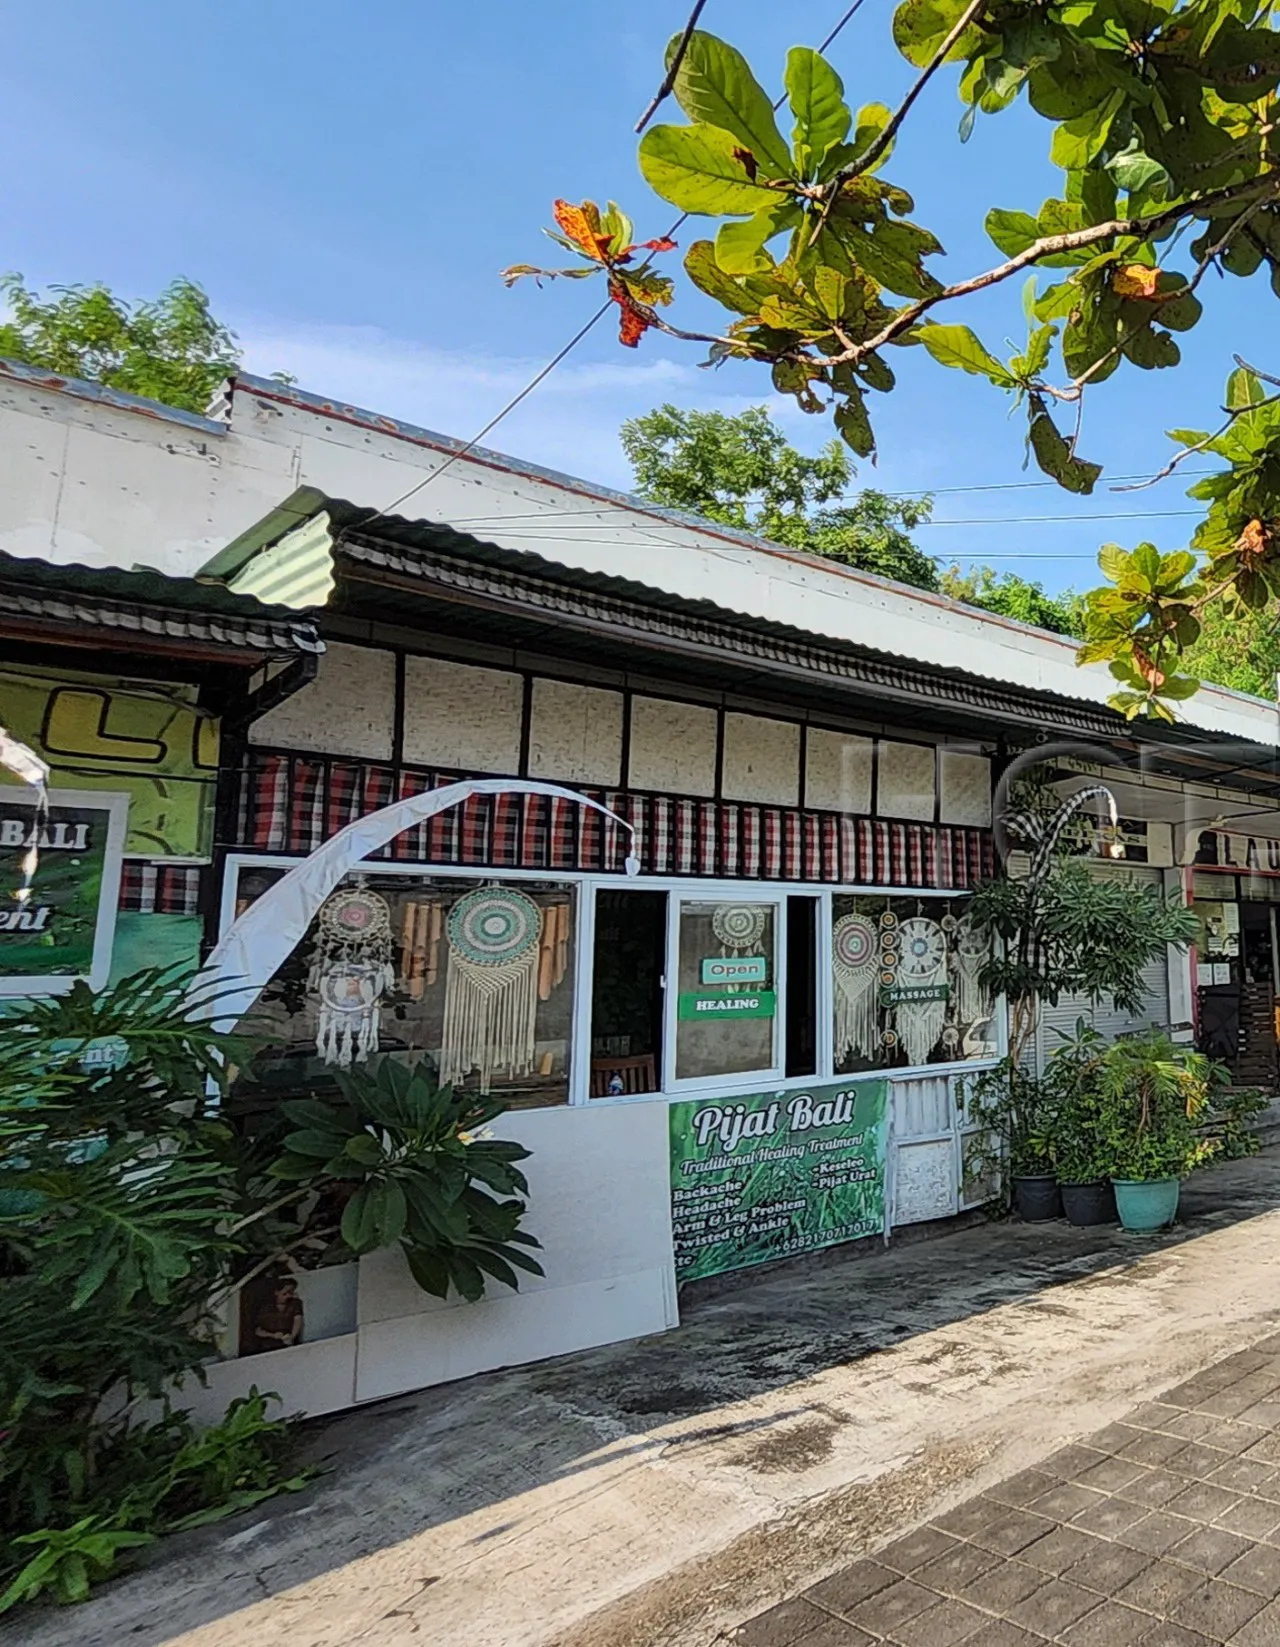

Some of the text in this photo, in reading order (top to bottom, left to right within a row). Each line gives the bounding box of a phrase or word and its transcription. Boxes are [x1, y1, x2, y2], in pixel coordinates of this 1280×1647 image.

[0, 819, 90, 850] BALI
[710, 964, 759, 978] Open
[696, 998, 760, 1012] HEALING
[889, 988, 941, 1002] MASSAGE
[694, 1091, 855, 1152] Pijat Bali
[681, 1134, 864, 1175] Traditional Healing Treatment
[849, 1169, 876, 1181] Urat
[673, 1180, 743, 1201] Backache
[673, 1197, 742, 1218] Headache
[673, 1200, 806, 1235] Arm & Leg Problem
[673, 1216, 790, 1249] Twisted & Ankle
